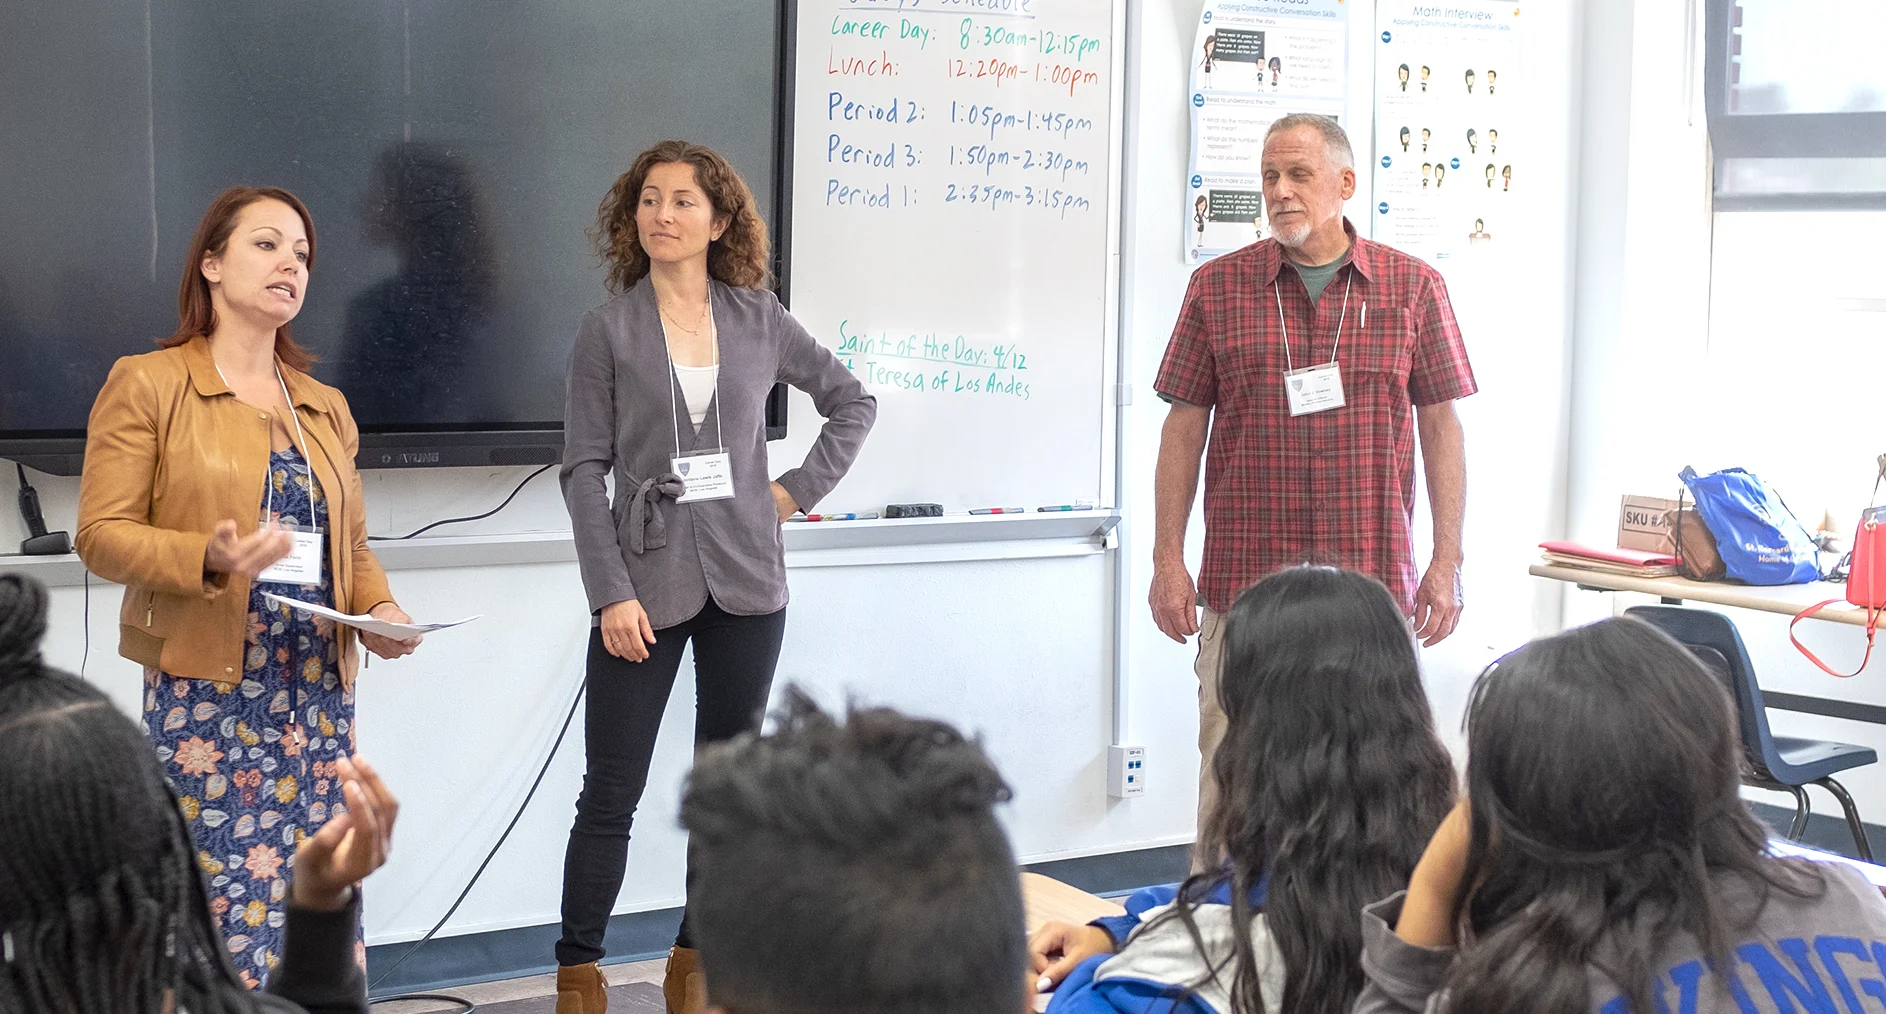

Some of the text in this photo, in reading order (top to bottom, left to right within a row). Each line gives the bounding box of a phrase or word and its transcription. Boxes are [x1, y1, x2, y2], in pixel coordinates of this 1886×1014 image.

[1241, 4, 1278, 14] Constructive
[1280, 7, 1321, 17] Conversation
[1413, 6, 1494, 20] Math Interview
[831, 14, 890, 40] Career
[900, 19, 937, 51] Day:
[828, 46, 899, 77] Lunch:
[829, 92, 1092, 140] Period 2: 1:05pm-1:45pm
[828, 134, 1089, 182] Period 3: 1:50pm-2:30pm
[826, 179, 889, 209] Period
[903, 185, 917, 207] 1:
[838, 319, 1028, 371] Saint of the Day: 4/12
[866, 361, 925, 393] Teresa
[932, 370, 949, 392] of
[955, 371, 981, 394] Los
[986, 371, 1031, 401] Andes
[1626, 512, 1648, 526] SKU
